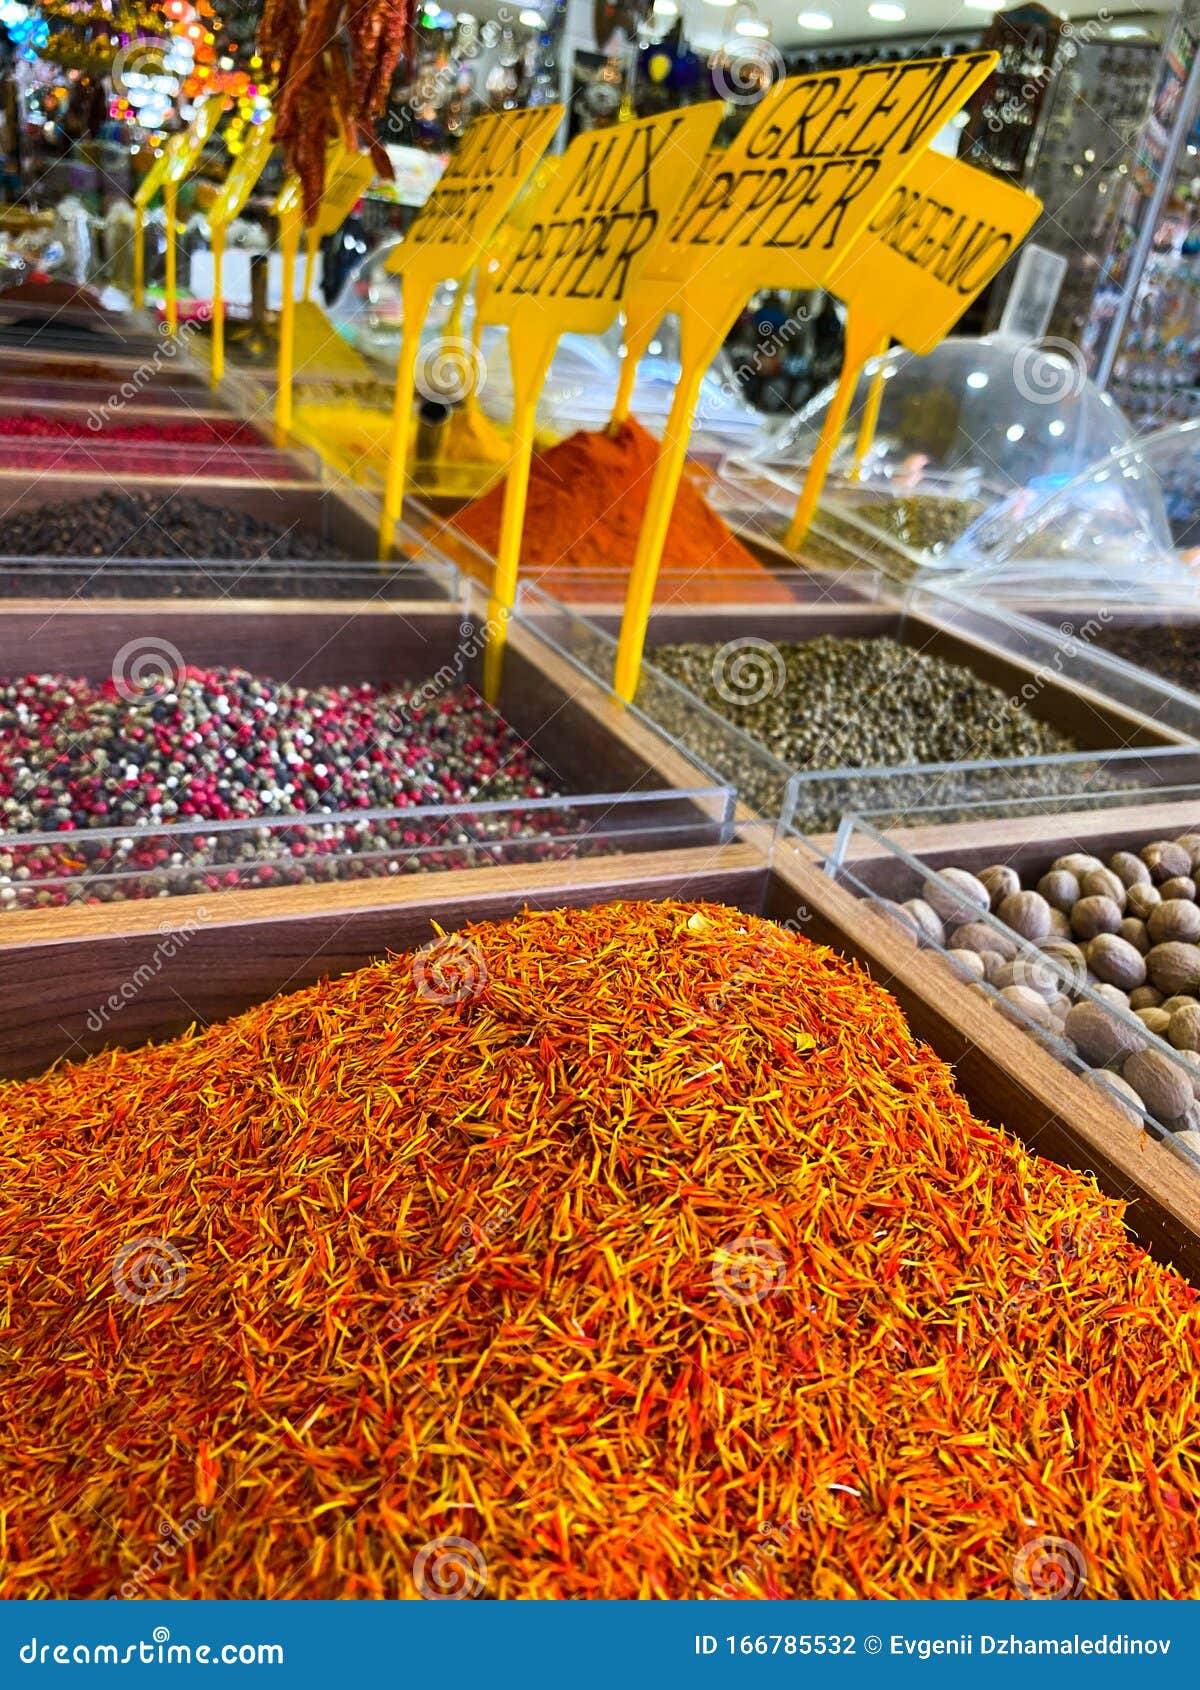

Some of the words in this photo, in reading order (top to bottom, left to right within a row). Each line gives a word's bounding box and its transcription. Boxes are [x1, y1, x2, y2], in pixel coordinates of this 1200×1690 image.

[746, 54, 992, 160] GREEN
[553, 117, 685, 215] MIX
[668, 158, 882, 250] PEPPER
[493, 208, 659, 302] PEPPER
[868, 185, 1013, 296] OREGANO
